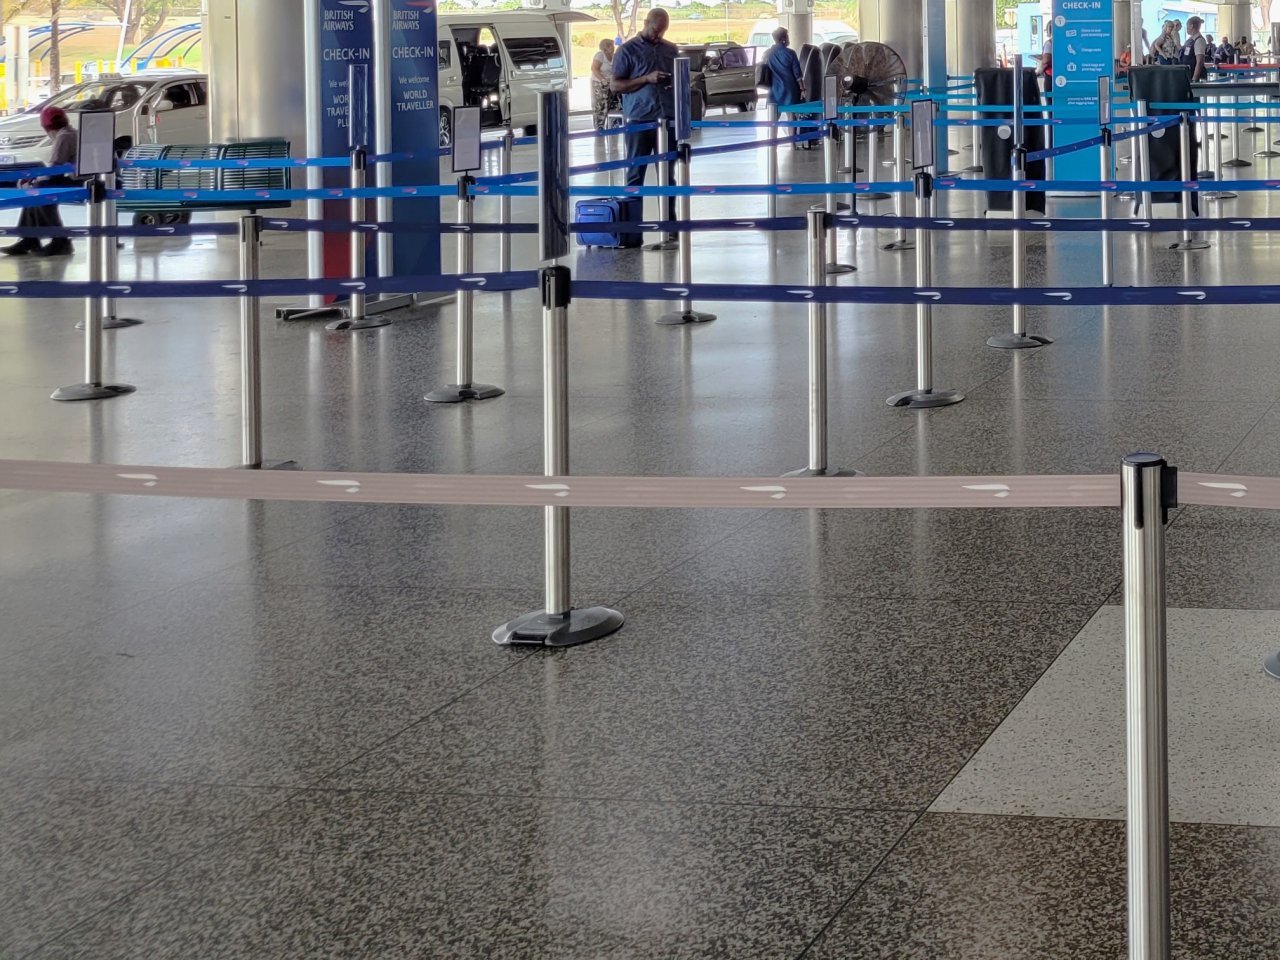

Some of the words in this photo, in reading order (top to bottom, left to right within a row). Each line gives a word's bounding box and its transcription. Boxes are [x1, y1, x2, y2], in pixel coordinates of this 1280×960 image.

[1062, 1, 1101, 9] CHECK-IN
[324, 10, 354, 21] BRITISH
[393, 10, 419, 20] BRITISH
[323, 21, 354, 31] AIRWAYS
[392, 20, 420, 30] AIRWAYS
[323, 48, 370, 61] CHECK-IN
[392, 46, 434, 59] CHECK-IN
[398, 76, 407, 84] We
[408, 76, 430, 84] welcome
[333, 95, 349, 104] WOR
[403, 90, 428, 100] WORLD
[396, 100, 434, 111] TRAVELLER
[327, 106, 349, 117] TRAVE
